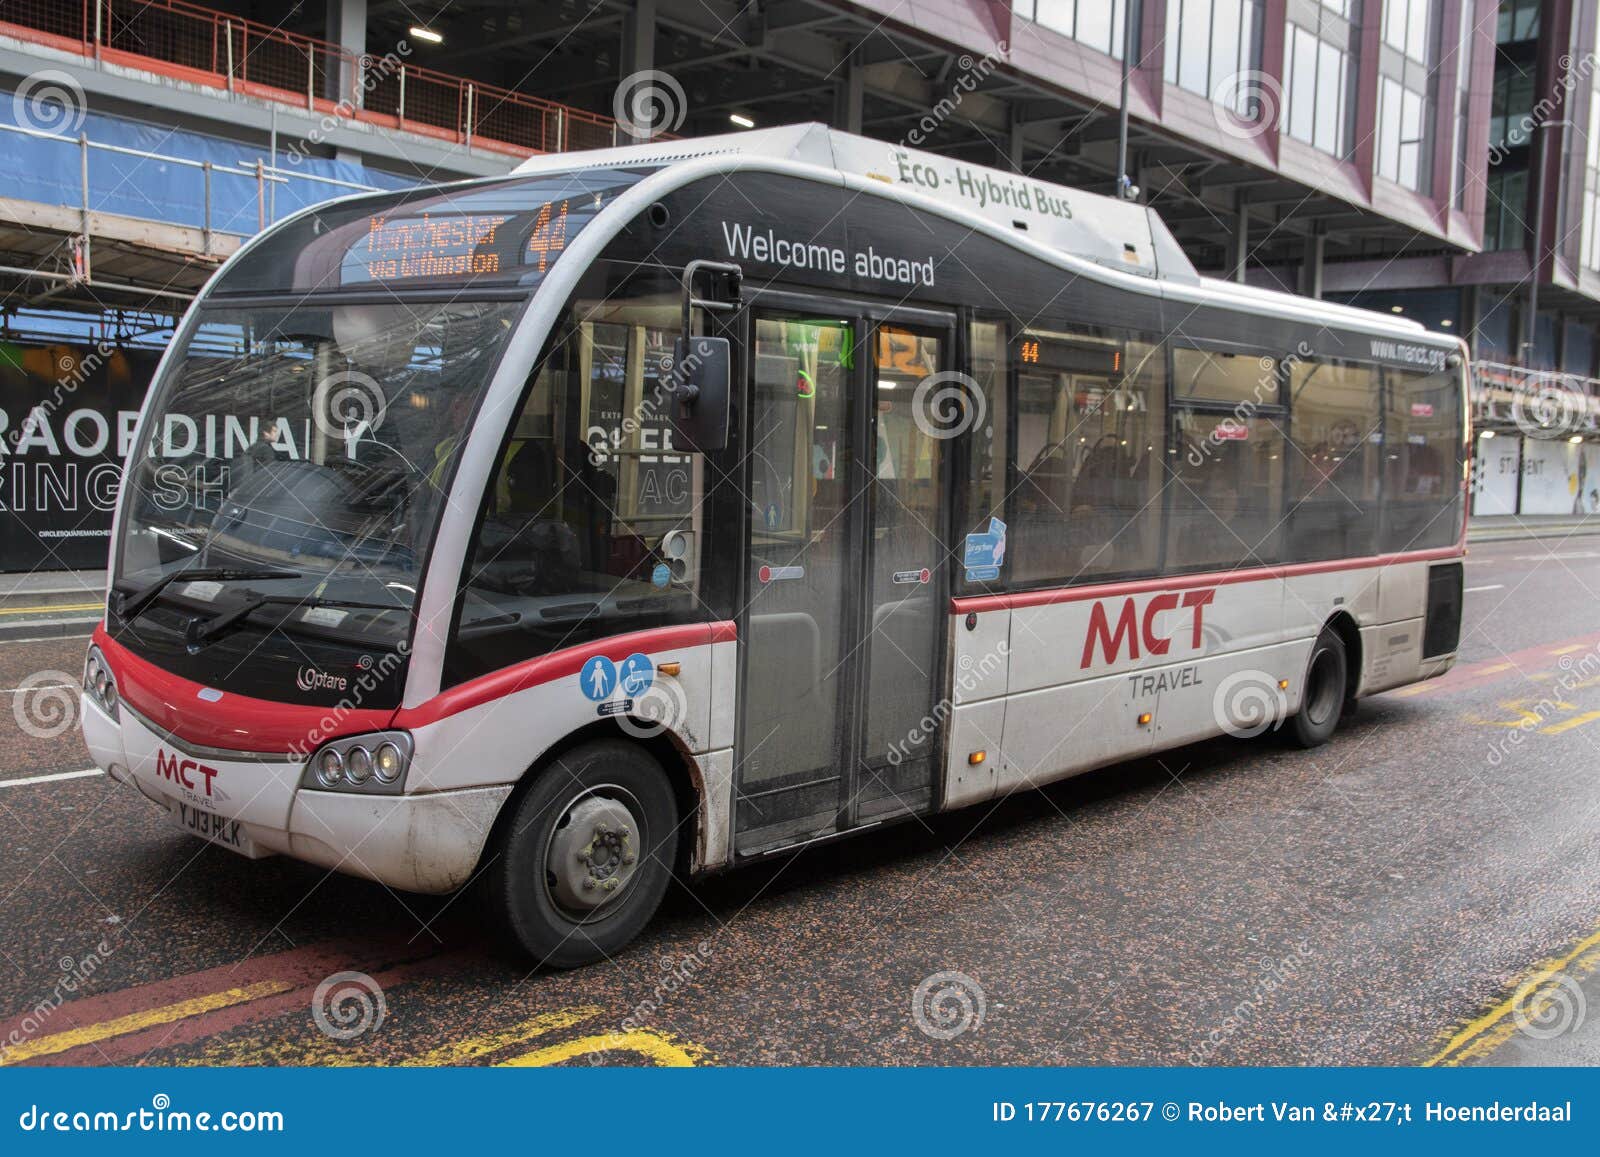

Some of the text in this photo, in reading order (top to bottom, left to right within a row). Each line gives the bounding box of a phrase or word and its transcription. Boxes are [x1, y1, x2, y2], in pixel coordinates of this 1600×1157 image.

[897, 153, 939, 189] Eco
[956, 167, 1032, 211] Hybrid
[1034, 187, 1073, 219] Bus
[530, 200, 568, 272] 44
[722, 221, 935, 287] Welcome aboard
[369, 254, 397, 277] via
[1021, 342, 1039, 363] 44
[1080, 589, 1216, 669] MCT
[303, 667, 348, 691] Optare
[1129, 666, 1202, 699] TRAVEL
[157, 748, 218, 796] MCT
[181, 787, 216, 810] TRAVEL
[180, 802, 240, 847] YJ13 HLK
